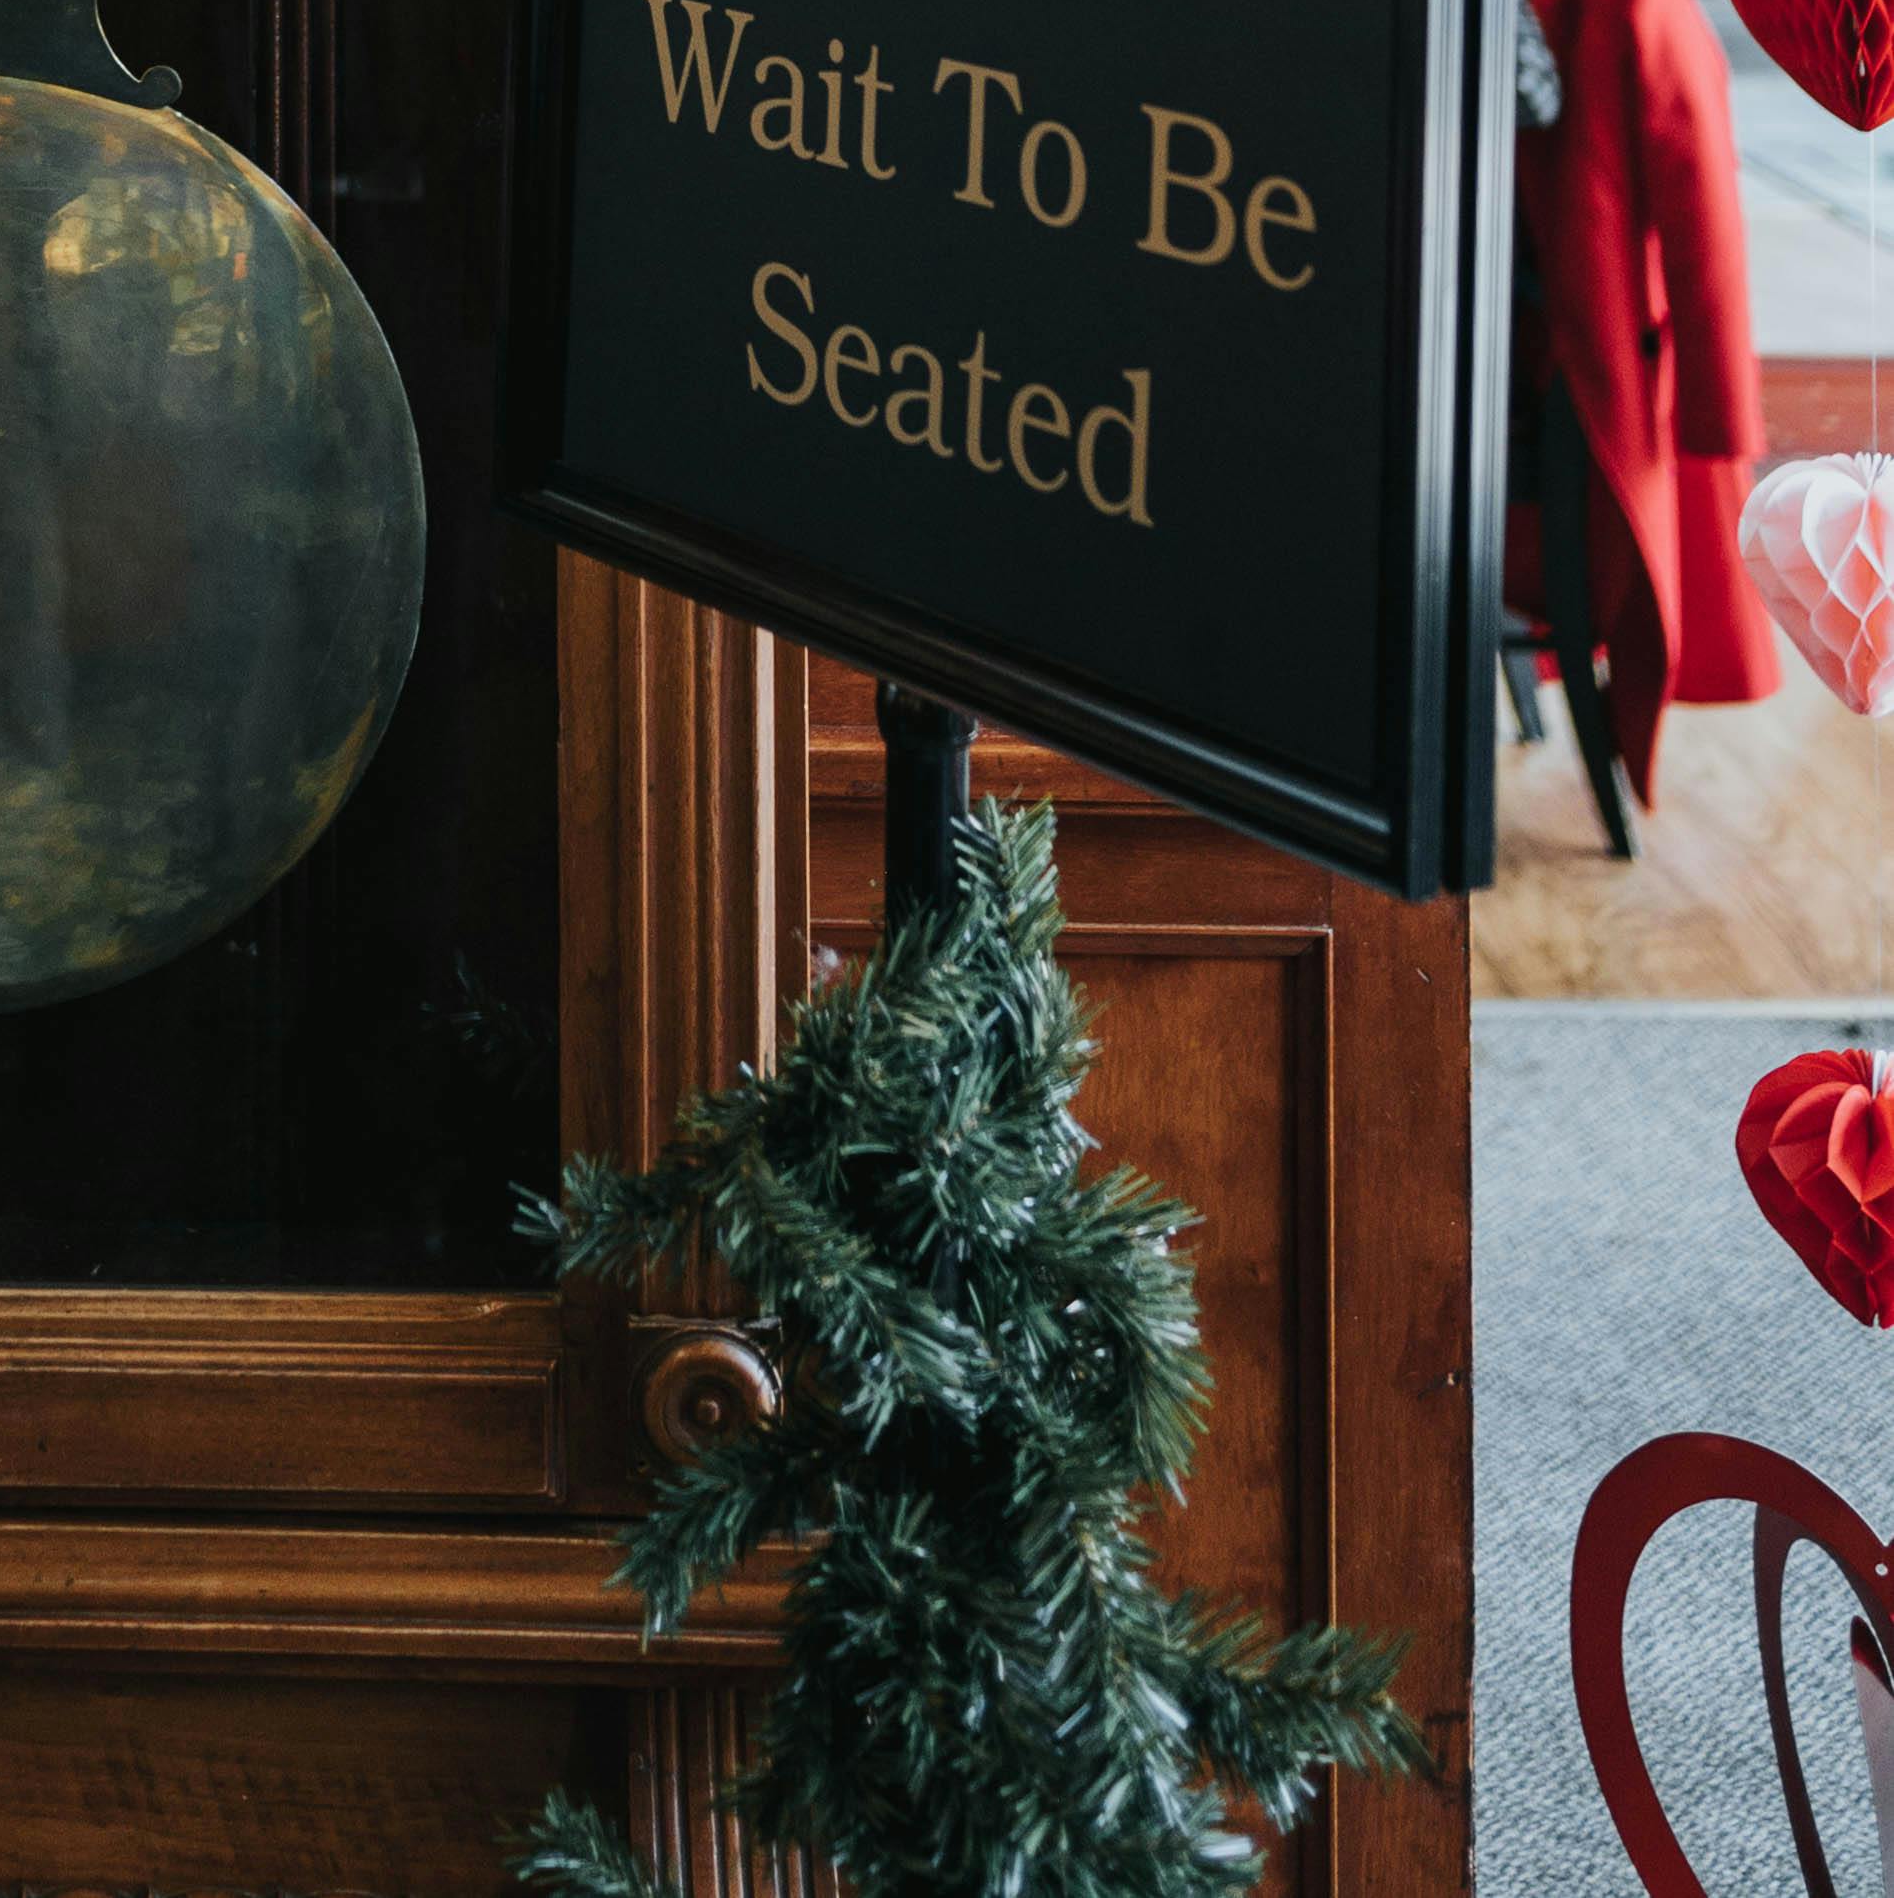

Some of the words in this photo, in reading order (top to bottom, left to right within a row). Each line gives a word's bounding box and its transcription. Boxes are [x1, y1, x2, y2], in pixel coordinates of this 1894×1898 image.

[933, 57, 1088, 228] To
[1136, 103, 1318, 291] Be
[746, 261, 1155, 528] Seated
